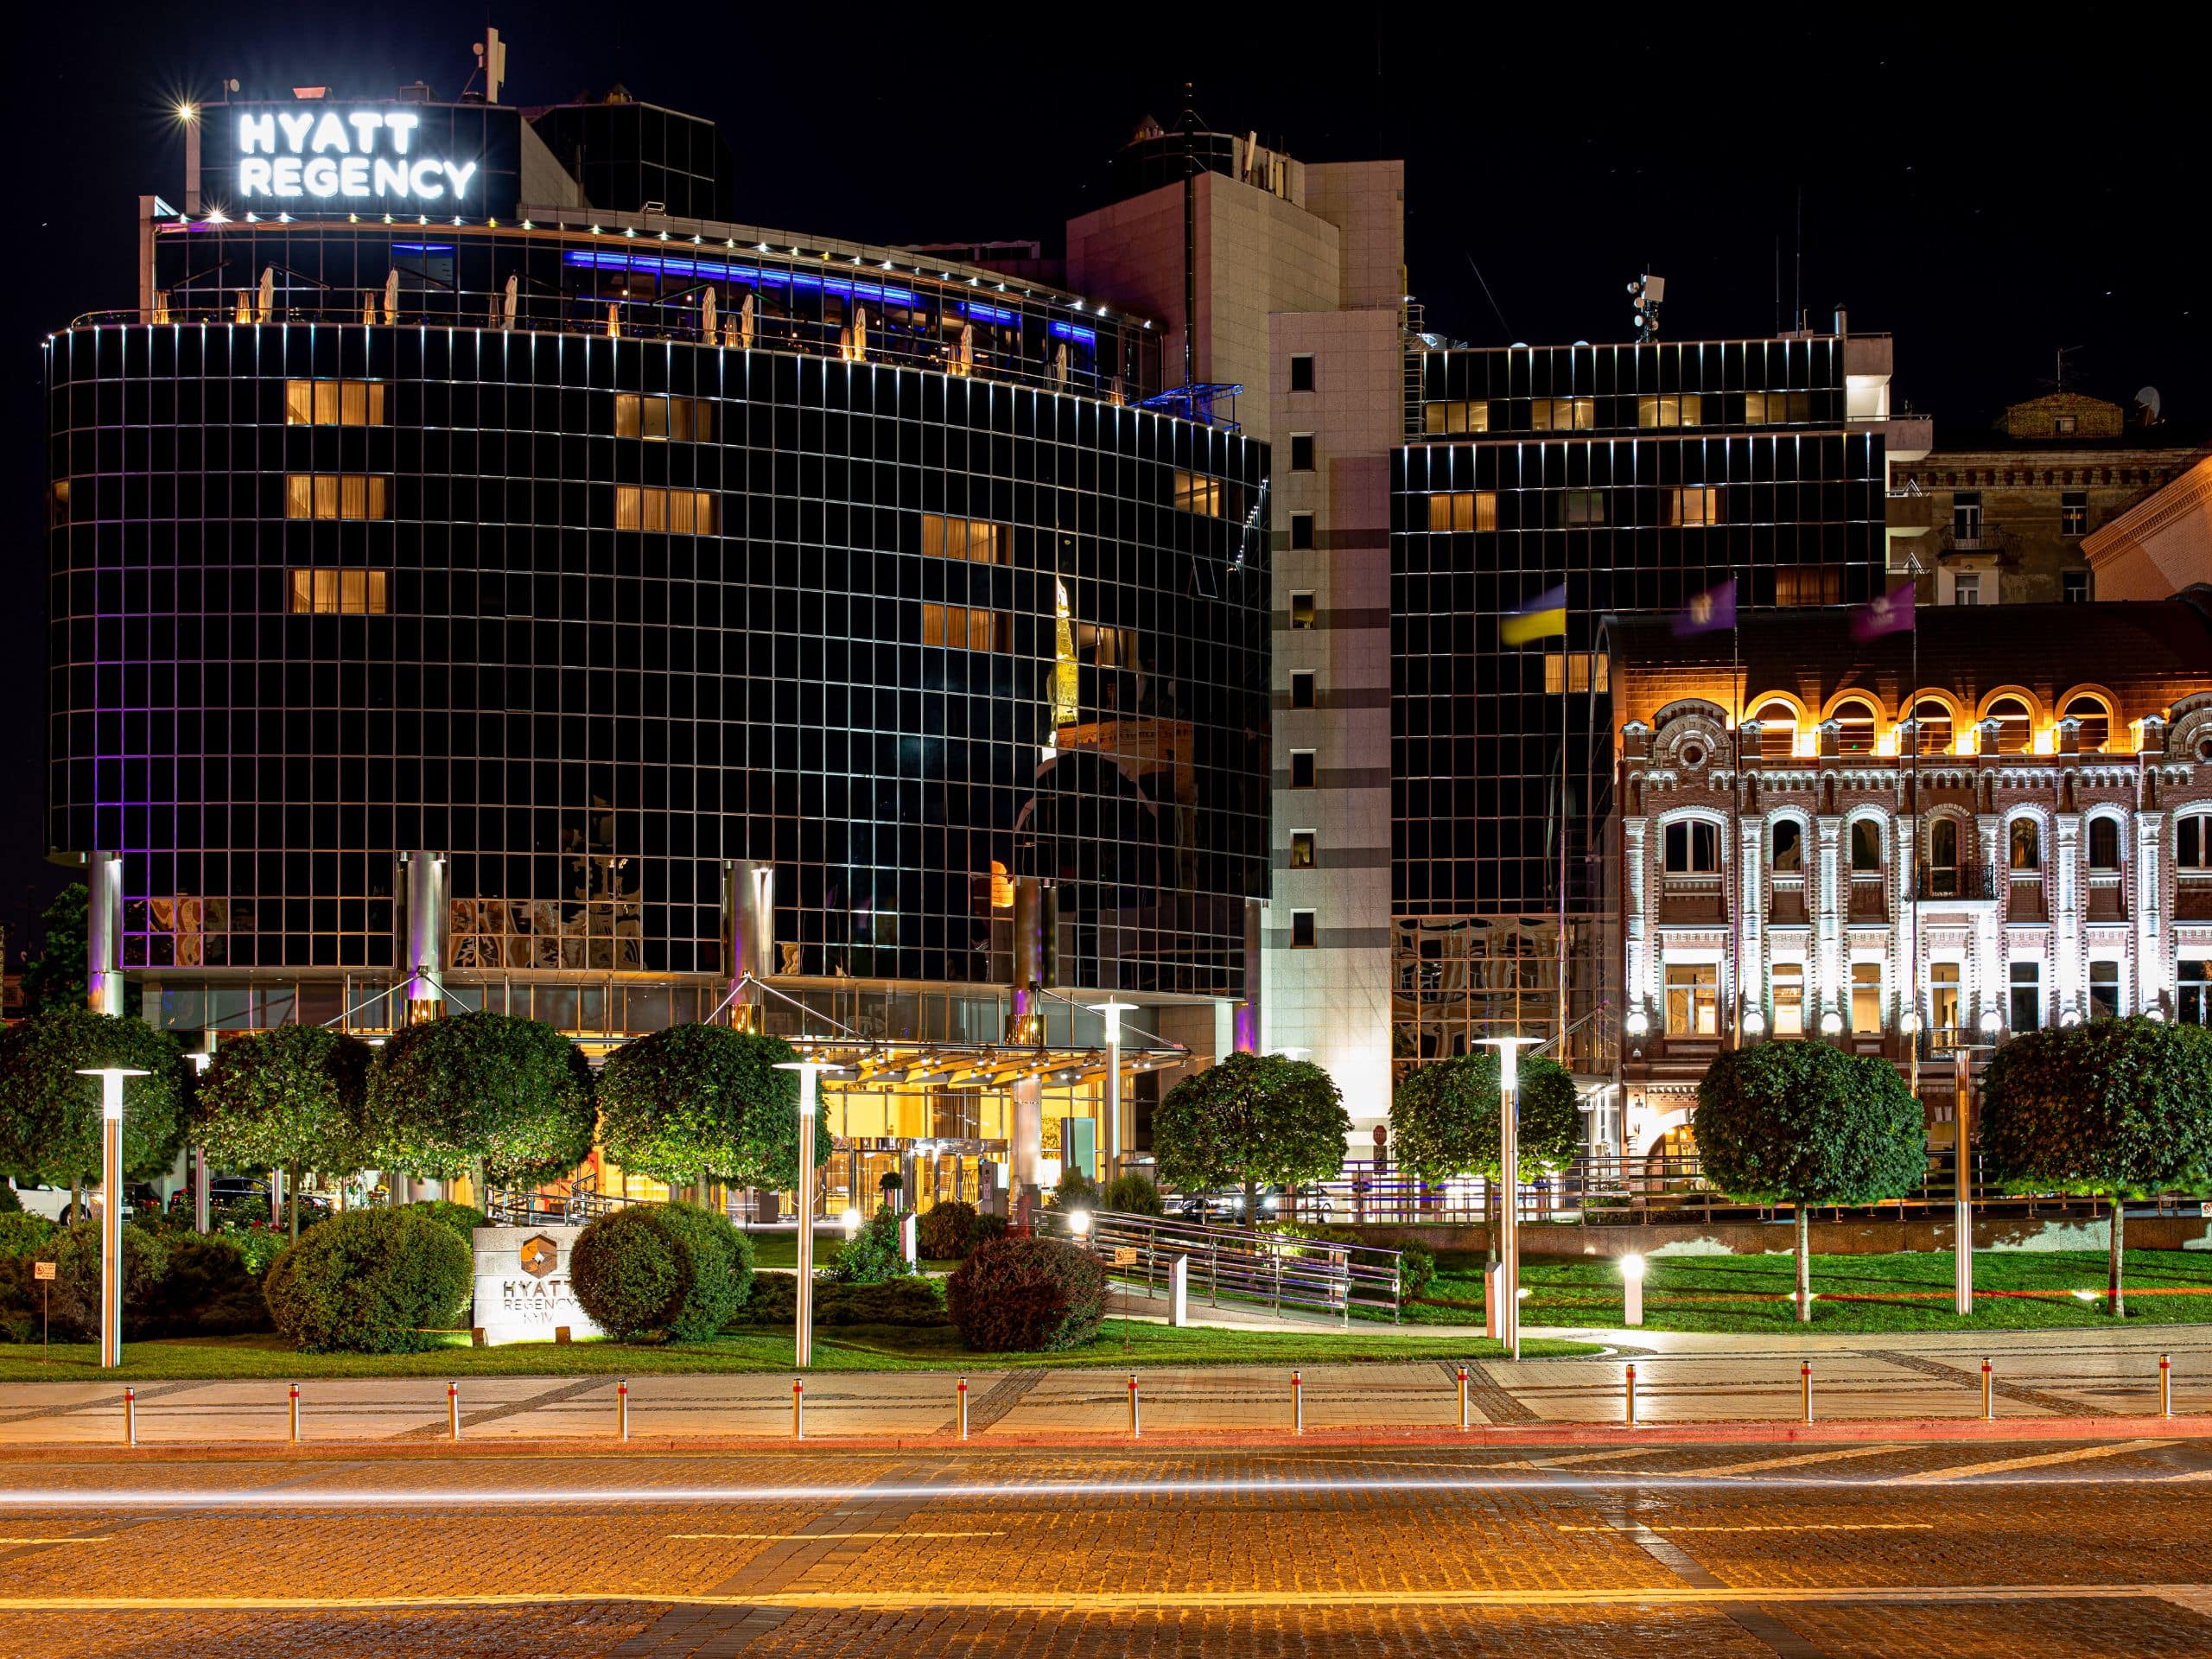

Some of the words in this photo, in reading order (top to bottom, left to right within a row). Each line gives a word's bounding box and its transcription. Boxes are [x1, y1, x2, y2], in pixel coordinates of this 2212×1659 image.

[240, 113, 418, 154] HYATT
[240, 157, 476, 199] REGENCY
[504, 1280, 575, 1297] HYATT
[504, 1298, 576, 1311] REGENCY
